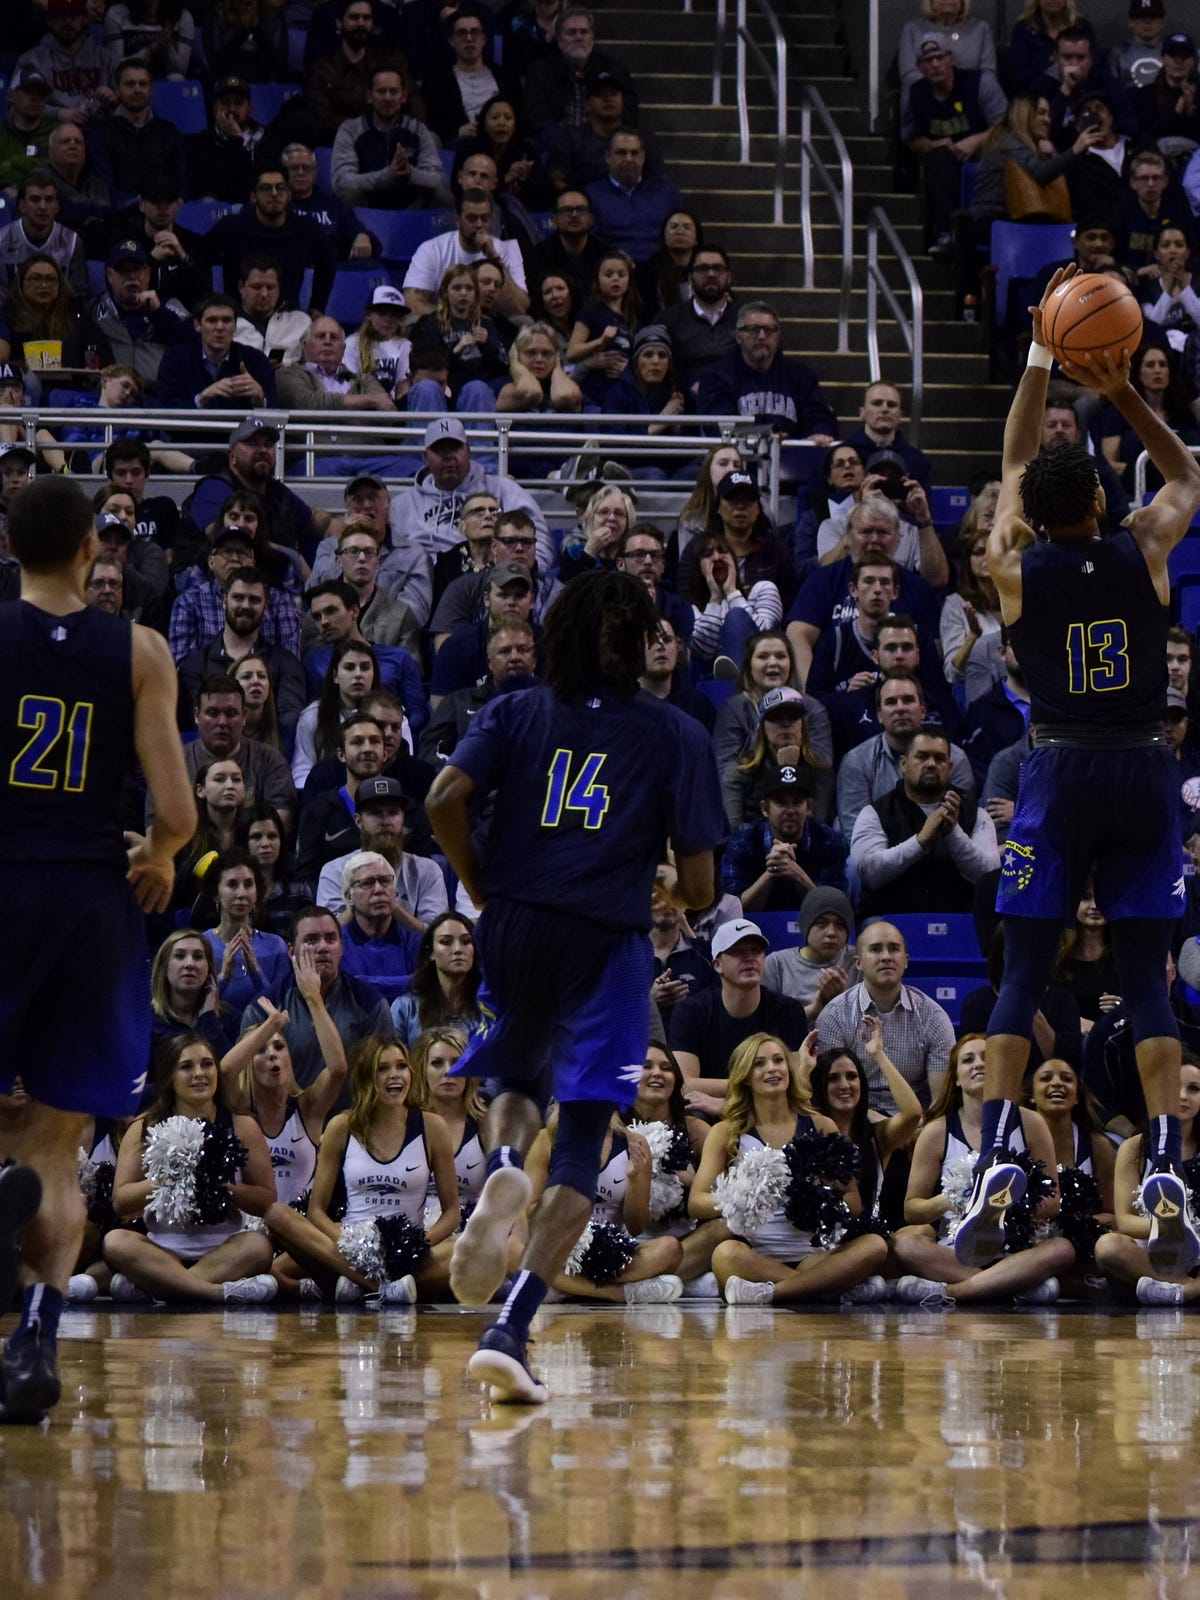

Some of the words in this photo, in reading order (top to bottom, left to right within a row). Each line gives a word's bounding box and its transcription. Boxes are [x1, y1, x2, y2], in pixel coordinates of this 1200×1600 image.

[440, 421, 450, 433] N
[1066, 619, 1131, 693] 13
[8, 694, 95, 793] 21
[541, 748, 611, 830] 14
[358, 1175, 408, 1190] NEVADA
[364, 1196, 402, 1207] CHEER
